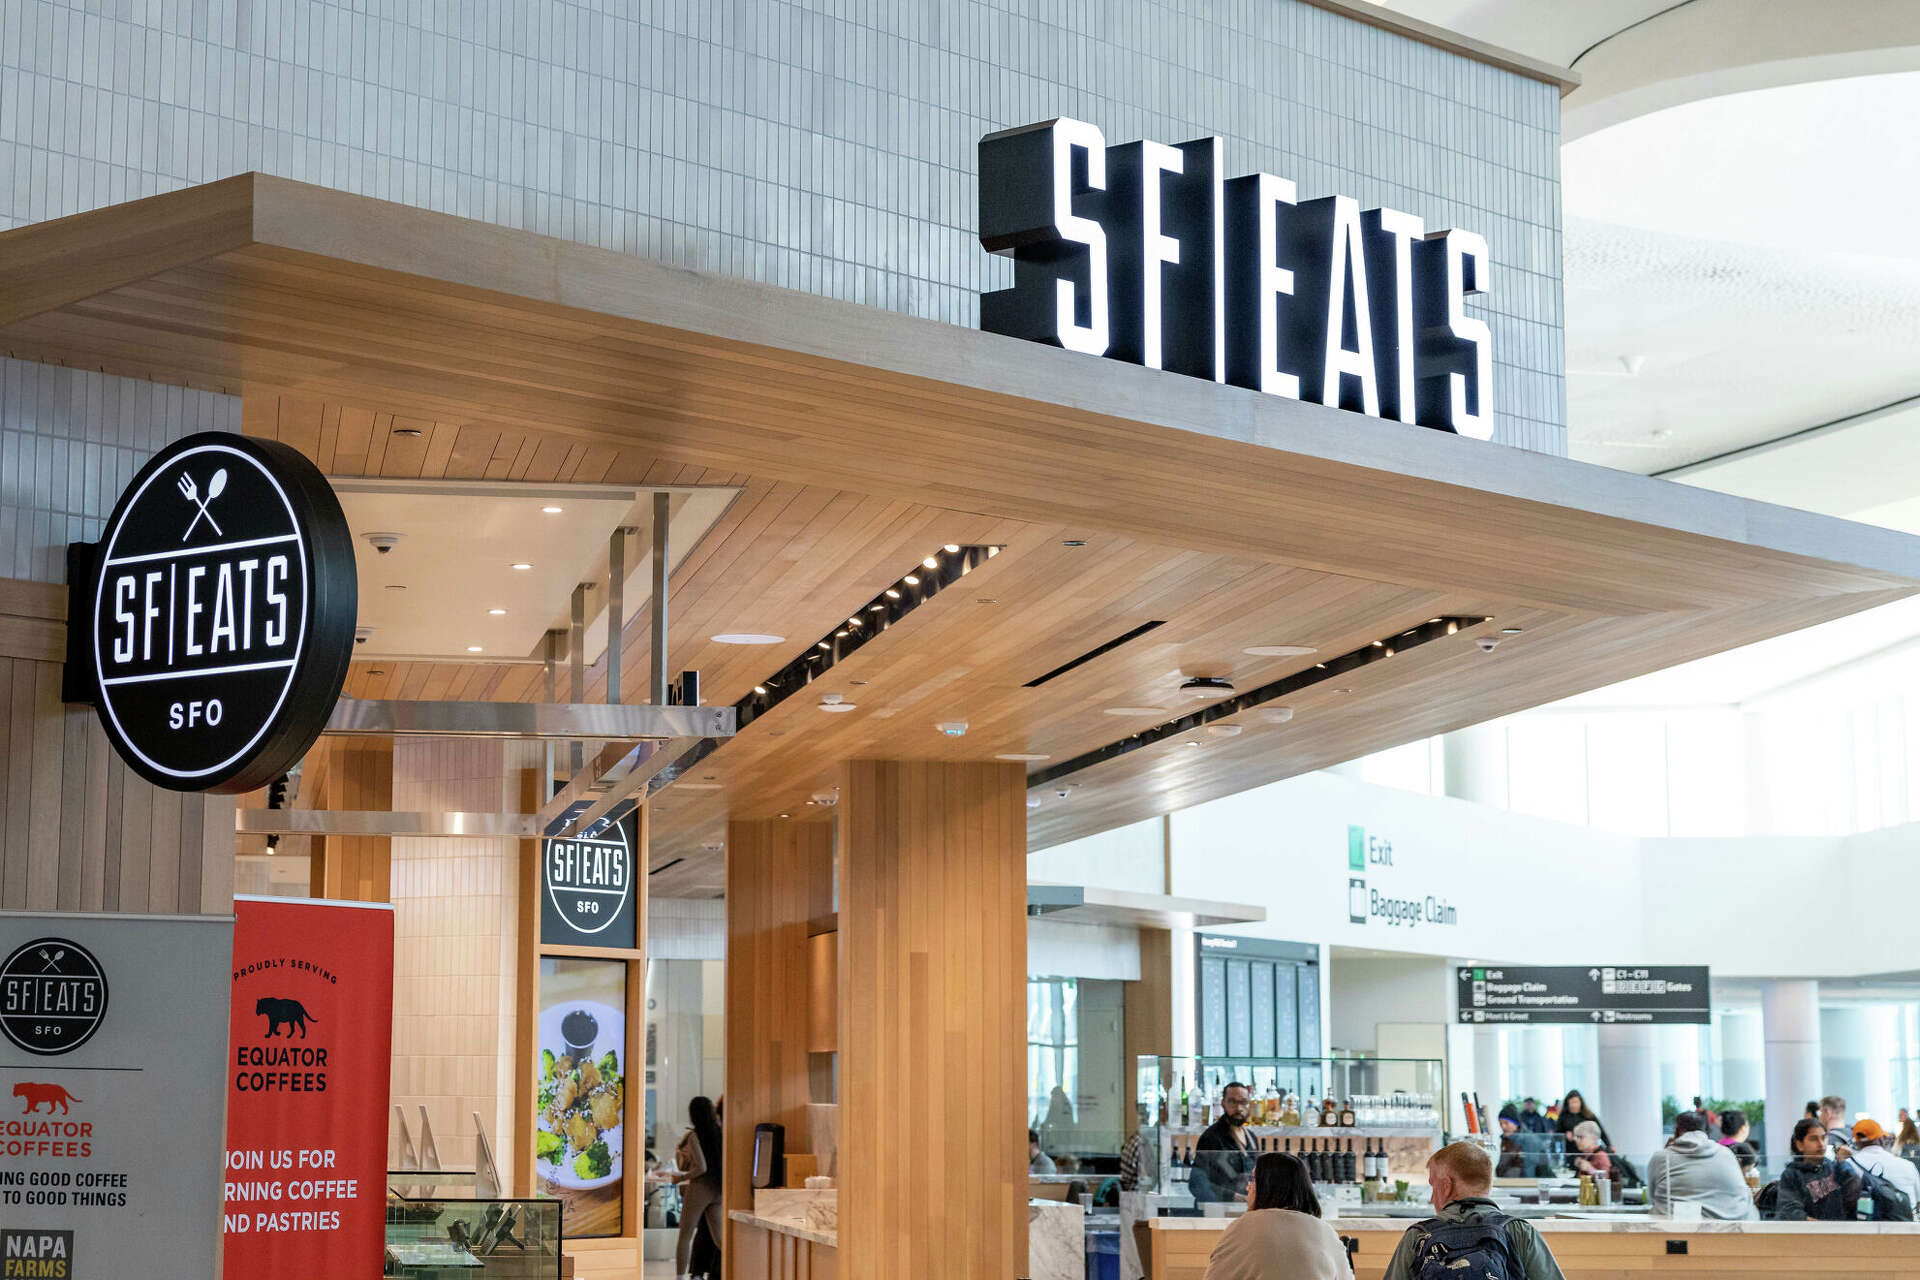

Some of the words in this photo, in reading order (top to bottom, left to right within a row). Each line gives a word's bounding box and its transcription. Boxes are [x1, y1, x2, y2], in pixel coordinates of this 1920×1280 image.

[169, 699, 224, 730] SFO
[1369, 836, 1393, 866] Exit
[577, 900, 599, 914] SFO
[1371, 888, 1422, 927] Baggage
[1425, 895, 1457, 926] Claim
[233, 958, 285, 981] PROUDLY
[291, 959, 337, 984] SERVING
[35, 1026, 62, 1035] SFO
[237, 1046, 327, 1068] EQUATOR
[236, 1072, 326, 1092] COFFEES
[270, 1150, 293, 1169] US
[299, 1149, 336, 1168] FOR
[30, 1172, 71, 1187] GOOD
[76, 1173, 128, 1187] COFFEE
[288, 1179, 358, 1200] COFFEE
[3, 1190, 21, 1205] TO
[26, 1191, 67, 1206] GOOD
[72, 1192, 127, 1207] THINGS
[256, 1211, 340, 1232] PASTRIES
[6, 1235, 67, 1258] NAPA
[5, 1260, 67, 1278] FARMS
